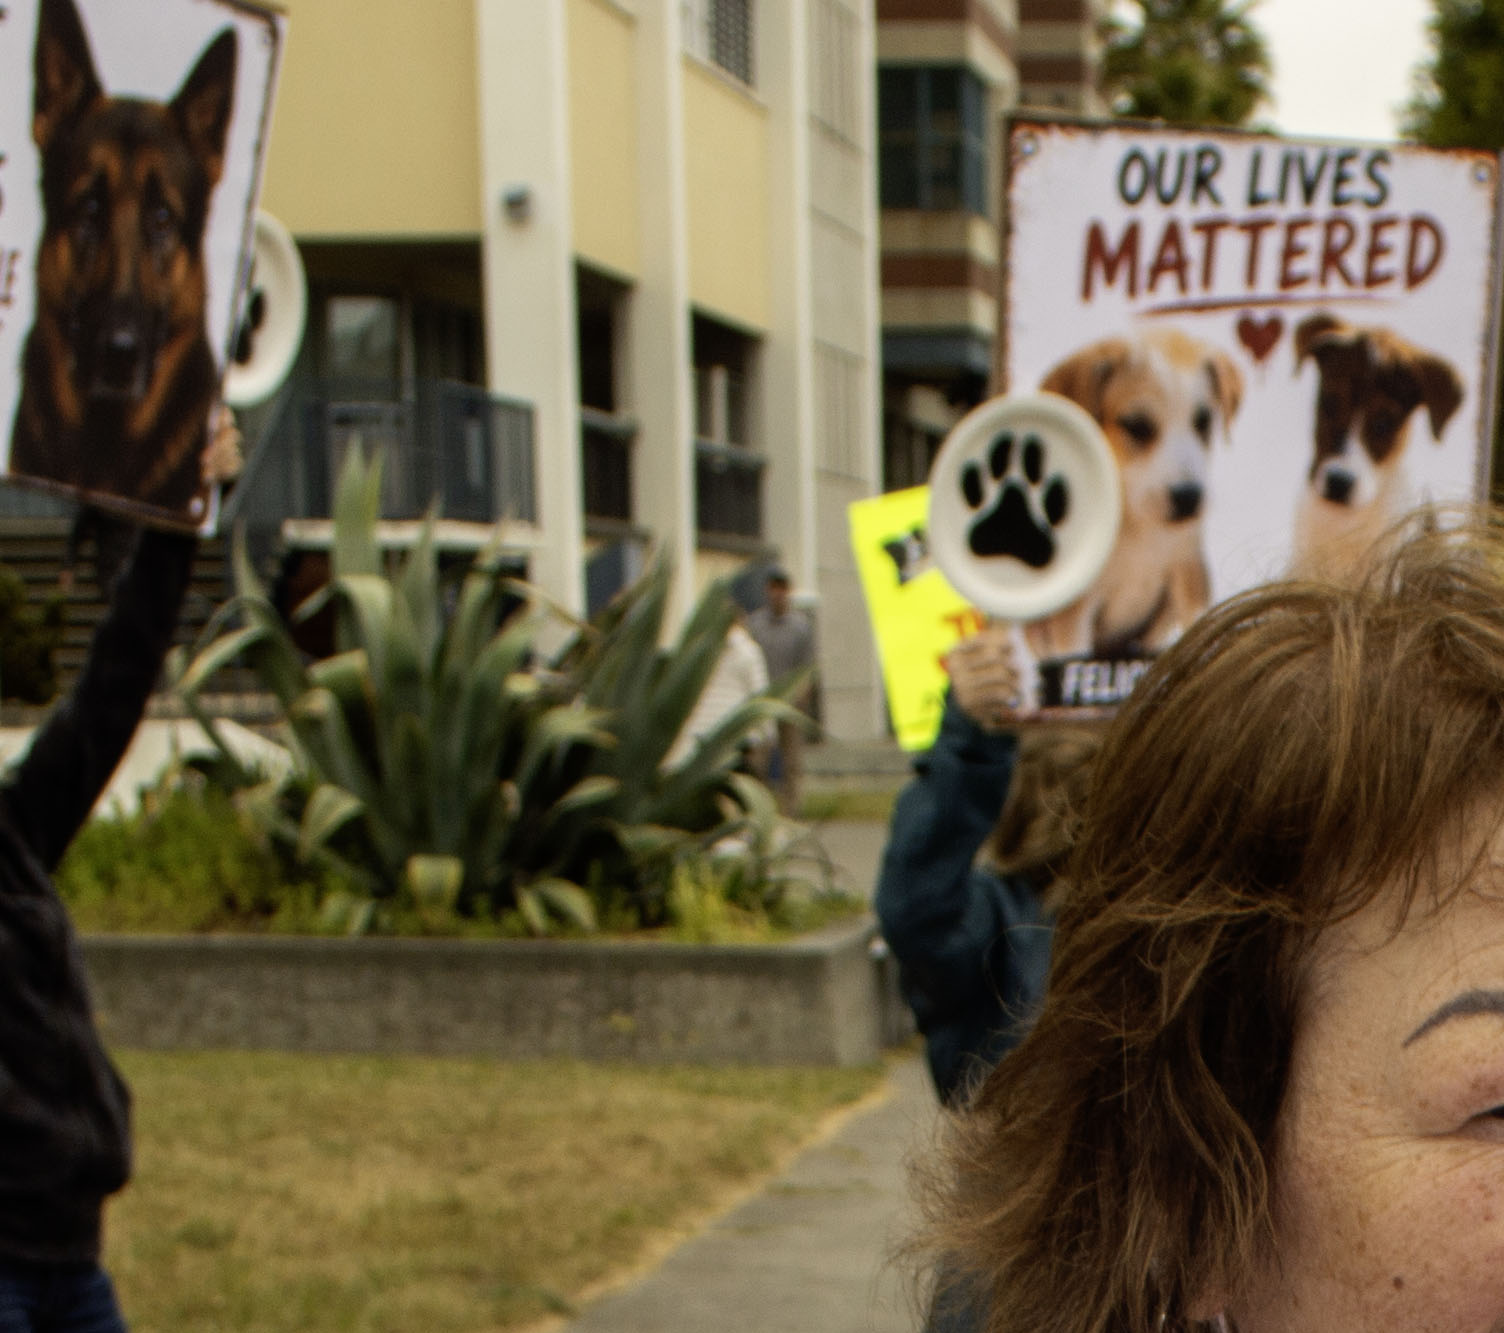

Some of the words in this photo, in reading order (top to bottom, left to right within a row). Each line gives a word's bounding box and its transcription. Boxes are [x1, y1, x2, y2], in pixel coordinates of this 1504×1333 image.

[1117, 146, 1225, 207] OUR
[1246, 148, 1391, 208] LIVES
[1081, 212, 1447, 302] MATTERED
